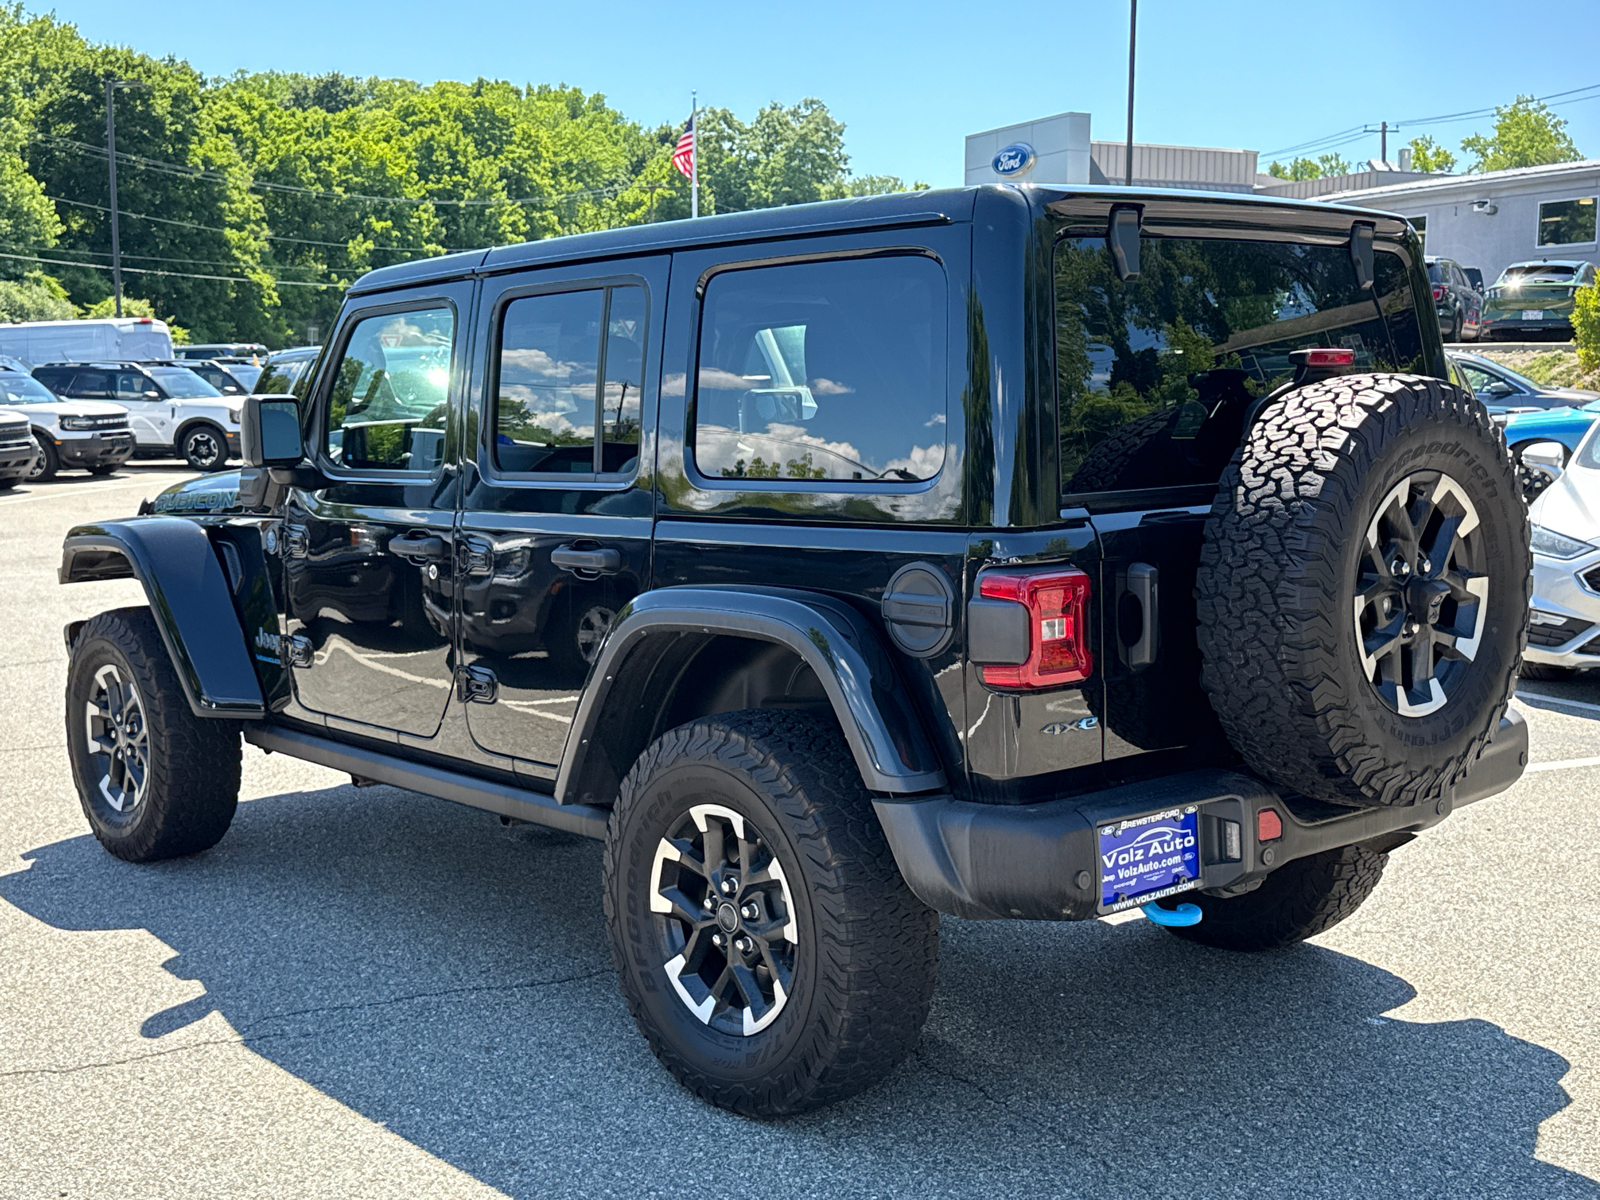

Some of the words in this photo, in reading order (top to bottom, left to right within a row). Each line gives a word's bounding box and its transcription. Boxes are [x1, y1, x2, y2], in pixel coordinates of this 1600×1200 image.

[998, 151, 1021, 171] Ford
[154, 491, 237, 511] RUBICON
[1102, 848, 1144, 868] Volz
[1148, 836, 1195, 857] Auto
[1117, 855, 1181, 879] VolzAuto.com
[1171, 866, 1185, 874] GMC
[1112, 881, 1195, 911] WWW.VOLZAUTO.COM
